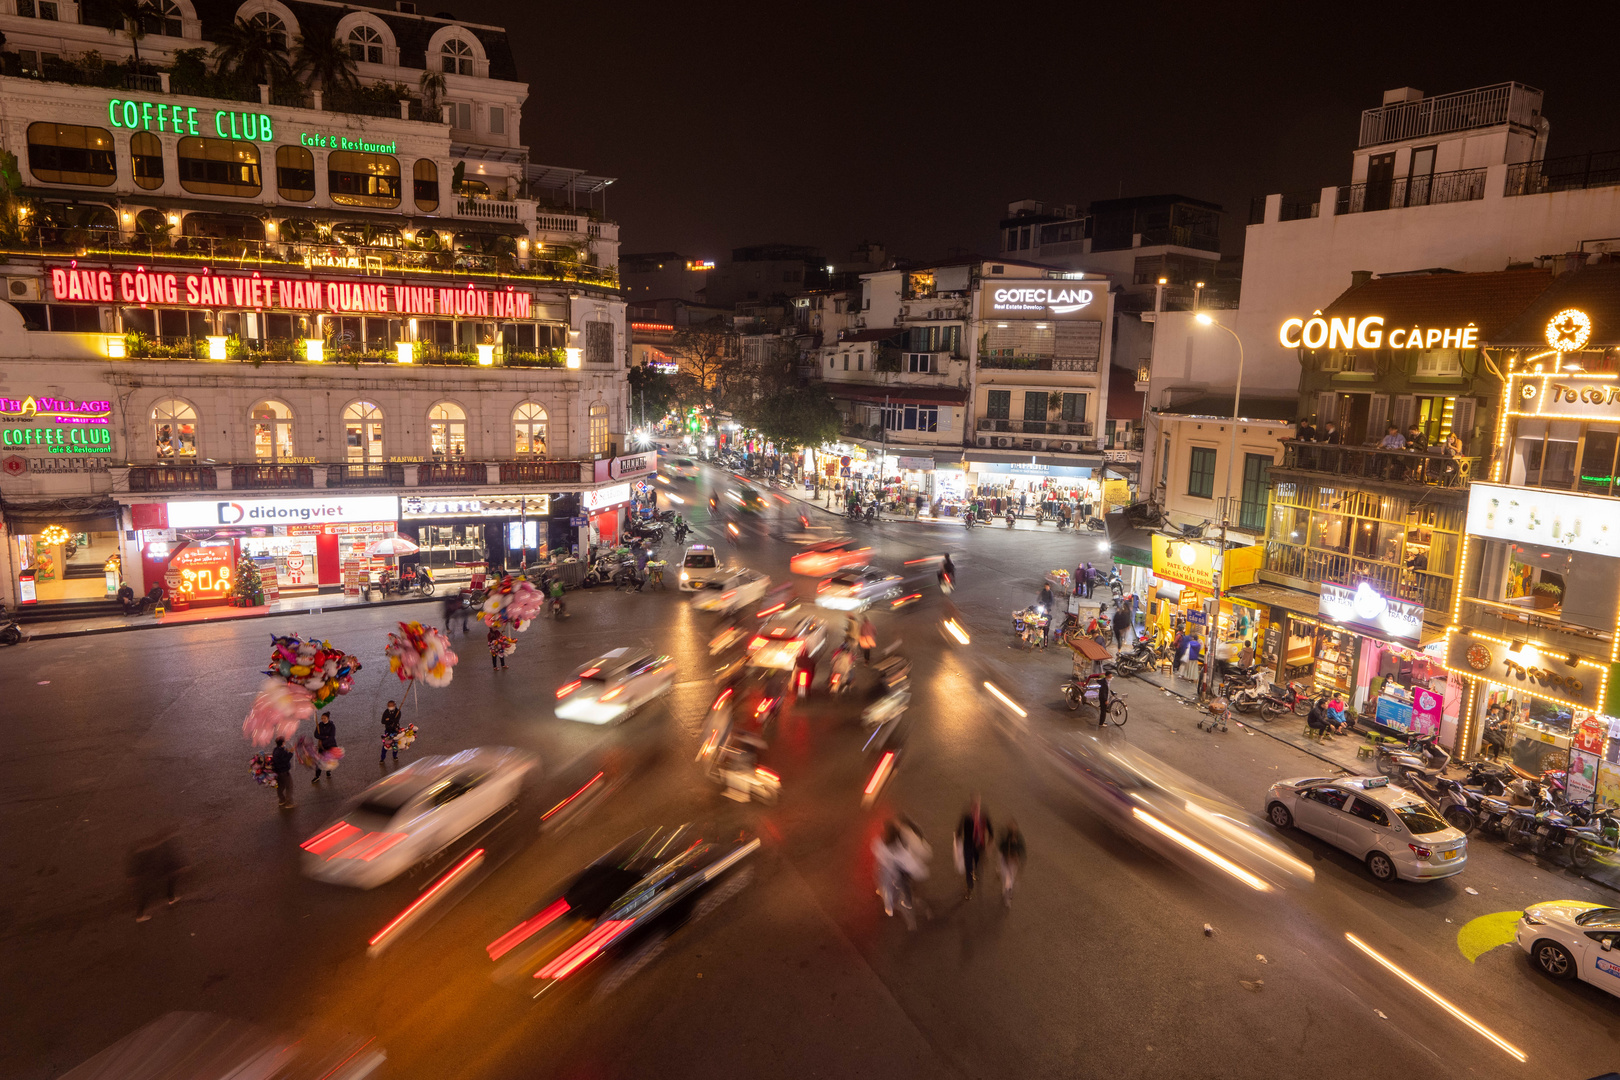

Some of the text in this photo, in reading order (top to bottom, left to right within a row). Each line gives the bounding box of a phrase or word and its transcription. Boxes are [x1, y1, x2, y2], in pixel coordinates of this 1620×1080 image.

[109, 99, 273, 142] COFFEE CLUB
[301, 132, 397, 154] Café & Restaurant
[52, 259, 531, 319] ĐẢNG CỘNG SẢN VIỆT NAM QUANG VINH MUÔN NĂM
[3, 428, 111, 445] COFFEE CLUB
[48, 445, 111, 453] Café & Restaurant
[30, 457, 112, 468] MANWAH
[249, 504, 344, 519] didongviet
